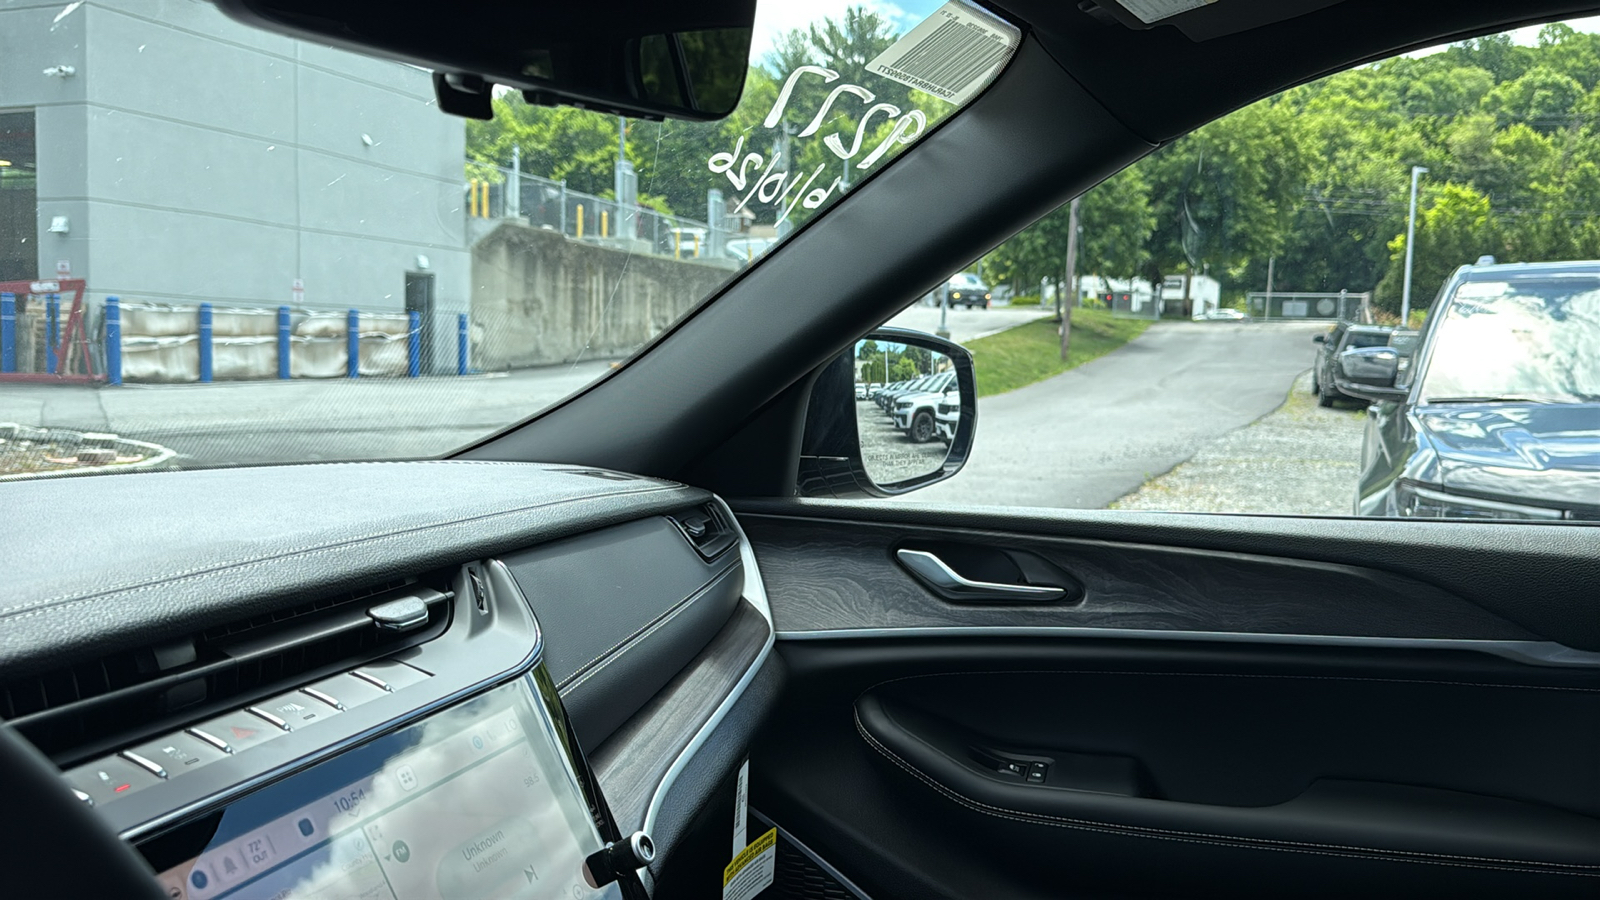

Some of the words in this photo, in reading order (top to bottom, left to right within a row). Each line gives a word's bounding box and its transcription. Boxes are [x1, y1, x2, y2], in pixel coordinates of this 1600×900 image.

[523, 773, 540, 788] 98.5
[333, 788, 366, 814] 10:54
[395, 846, 408, 857] FM
[462, 828, 505, 861] Unknown
[252, 850, 269, 865] OUT
[472, 847, 509, 874] Unknown
